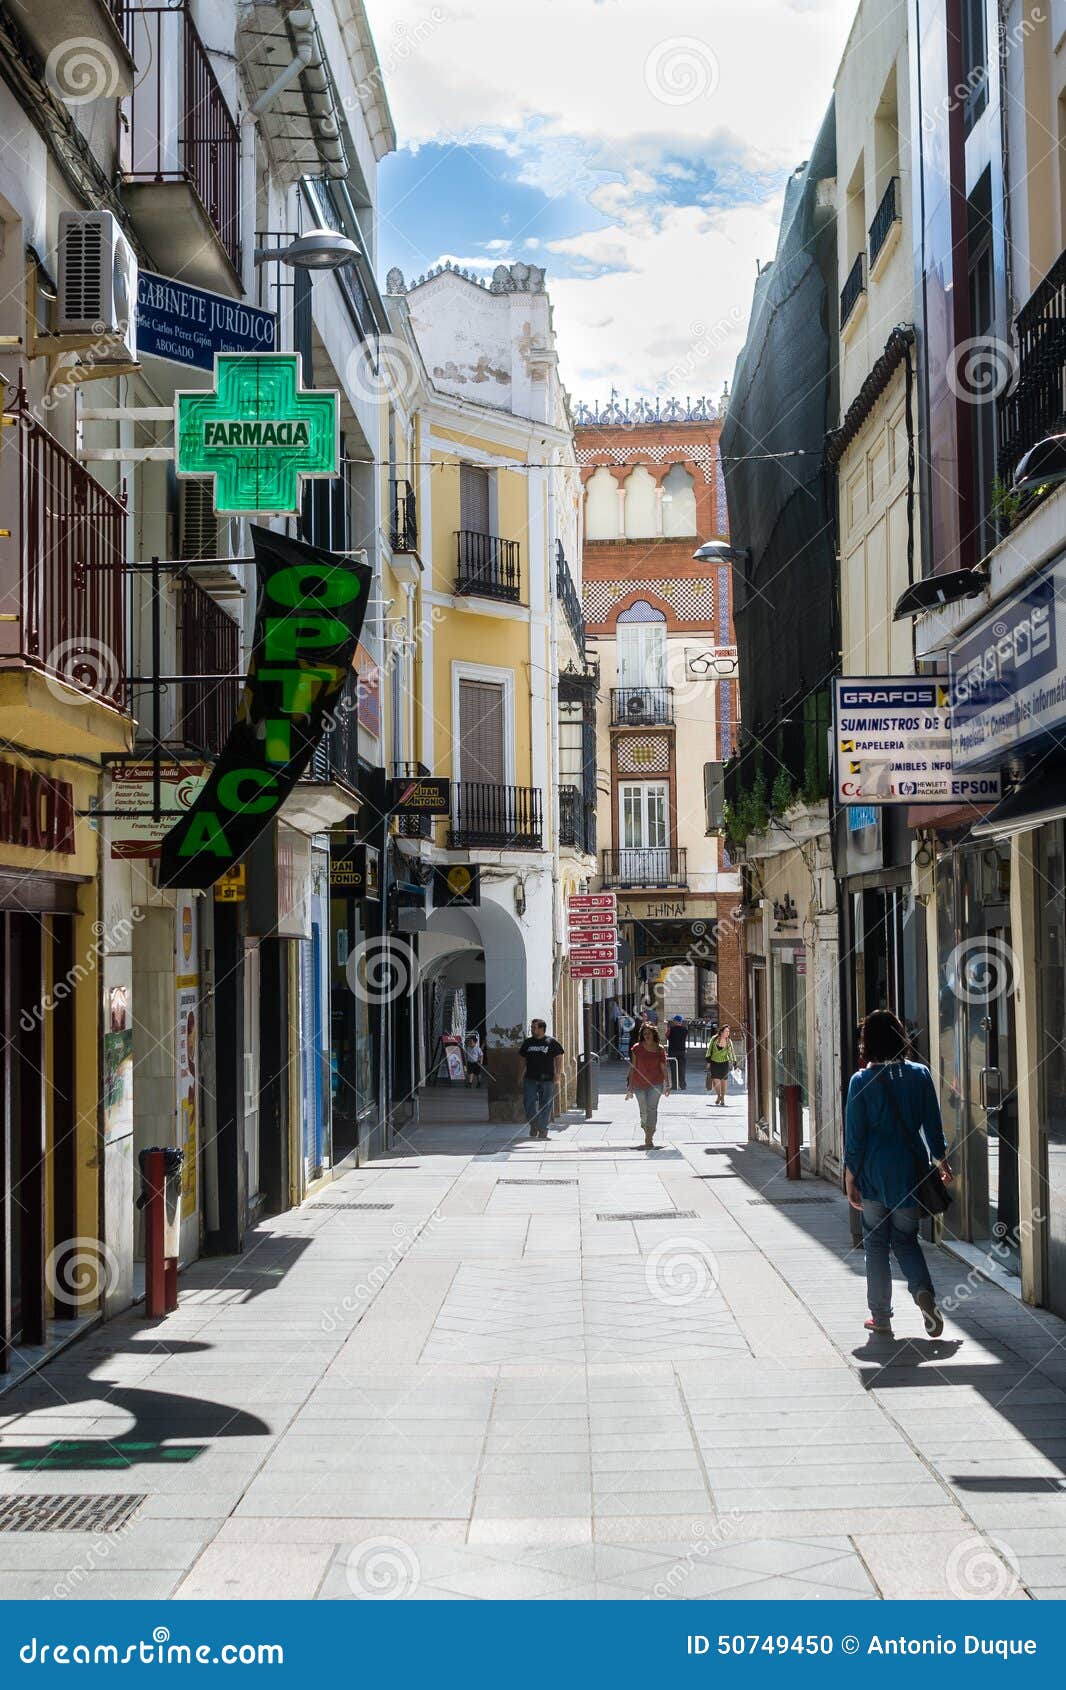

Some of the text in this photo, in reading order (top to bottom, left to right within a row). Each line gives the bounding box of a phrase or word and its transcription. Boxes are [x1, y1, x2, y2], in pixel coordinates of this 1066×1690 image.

[138, 278, 274, 344] GABINETE JURÍDICO
[152, 318, 174, 336] Carlos
[174, 325, 193, 341] Pérez
[155, 338, 195, 360] ABOGADO
[203, 422, 309, 446] FARMACIA
[843, 691, 933, 704] GRAFOS
[177, 564, 361, 858] OPTICA
[840, 717, 920, 731] SUMINISTROS
[924, 717, 939, 730] DE
[855, 741, 905, 750] PAPELERIA
[931, 761, 951, 771] INFO
[414, 783, 439, 796] JUAN
[952, 780, 998, 794] EPSON
[405, 796, 446, 807] ANTONIO
[330, 860, 353, 873] UAN
[330, 873, 362, 885] TONIO
